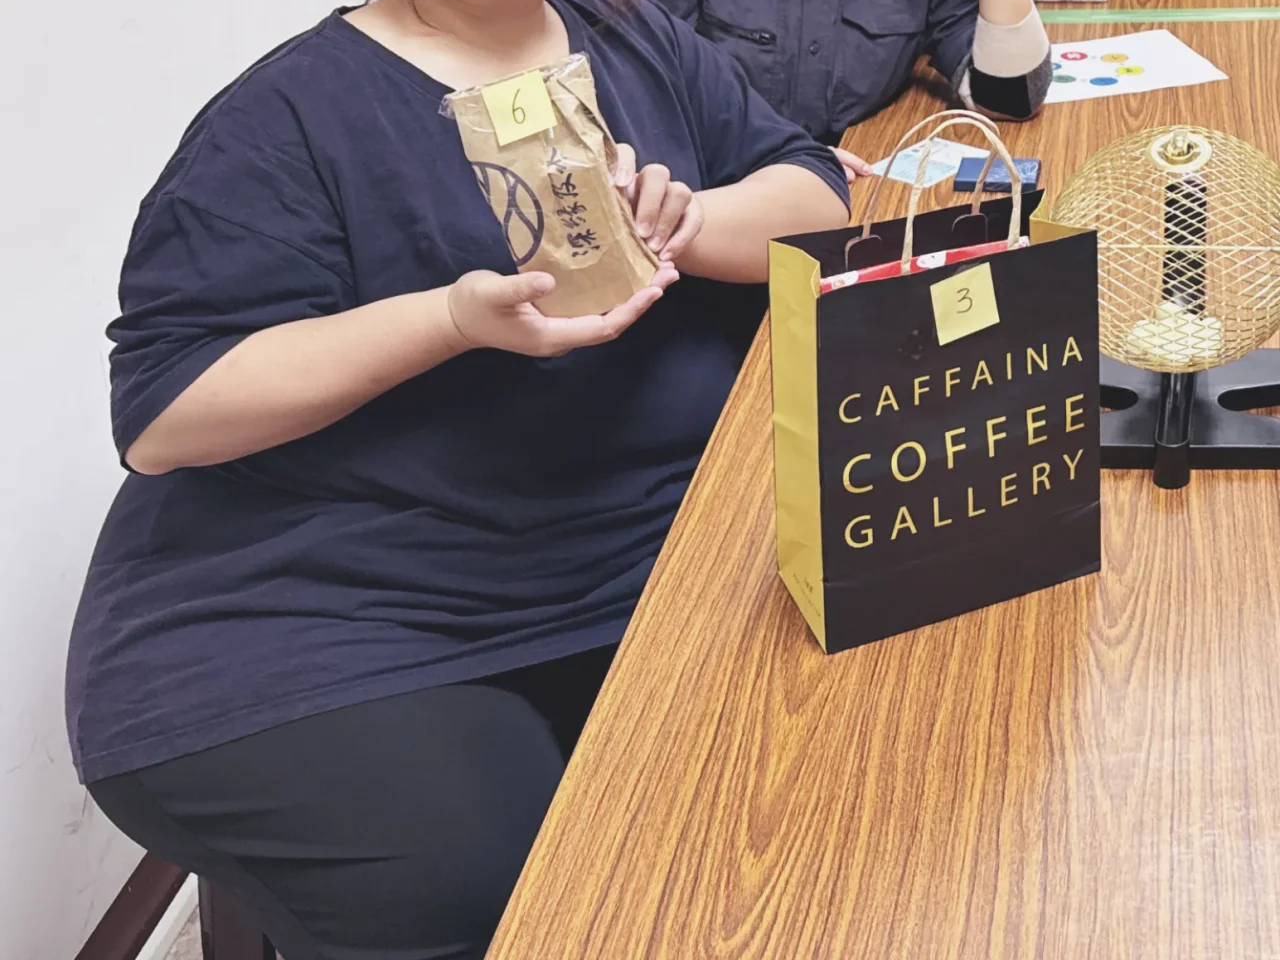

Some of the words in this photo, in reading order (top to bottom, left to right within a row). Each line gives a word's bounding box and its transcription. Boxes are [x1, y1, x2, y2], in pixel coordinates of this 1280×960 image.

[511, 87, 527, 125] 6
[956, 287, 974, 314] 3
[838, 336, 1083, 425] CAFFAINA
[842, 393, 1086, 495] COFFEE
[844, 448, 1086, 550] GALLERY
